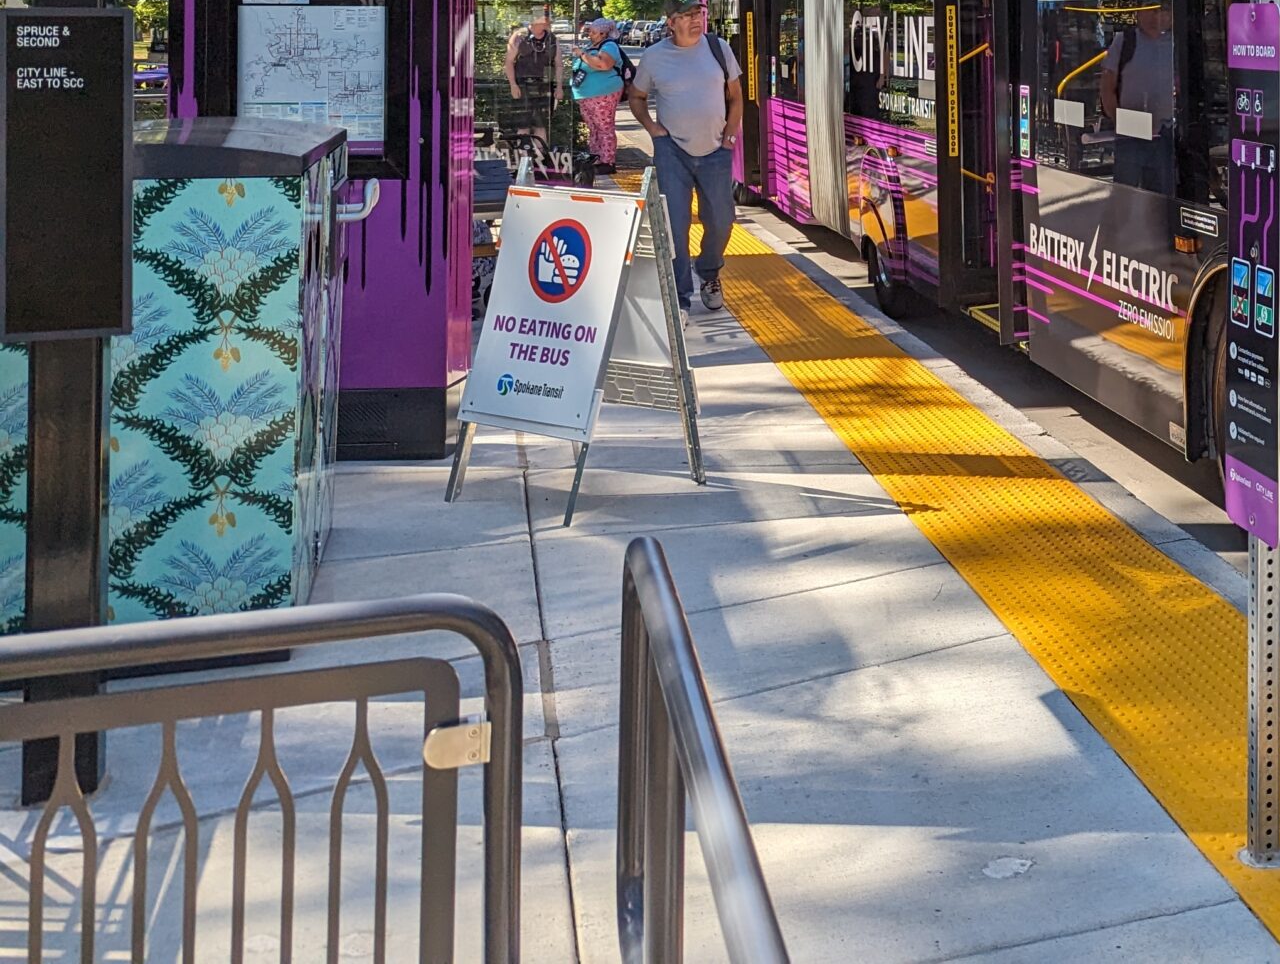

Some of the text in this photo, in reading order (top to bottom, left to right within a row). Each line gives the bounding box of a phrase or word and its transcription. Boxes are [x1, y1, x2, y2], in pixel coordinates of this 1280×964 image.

[16, 26, 70, 36] SPRUCE &
[16, 37, 60, 47] SECOND
[851, 10, 936, 80] CITY LINE
[1232, 44, 1276, 57] HOW TO BOARD
[16, 68, 41, 77] CITY
[43, 68, 67, 77] LINE
[16, 78, 84, 88] EAST TO SCC
[950, 83, 955, 96] TO
[878, 91, 936, 119] SPOKANE TRANSIT
[1029, 222, 1178, 314] BATTERY ELECTRIC
[1118, 299, 1138, 324] ZERO
[493, 315, 598, 344] NO EATING ON
[509, 342, 571, 367] THE BUS
[513, 379, 564, 399] Spokane Transit
